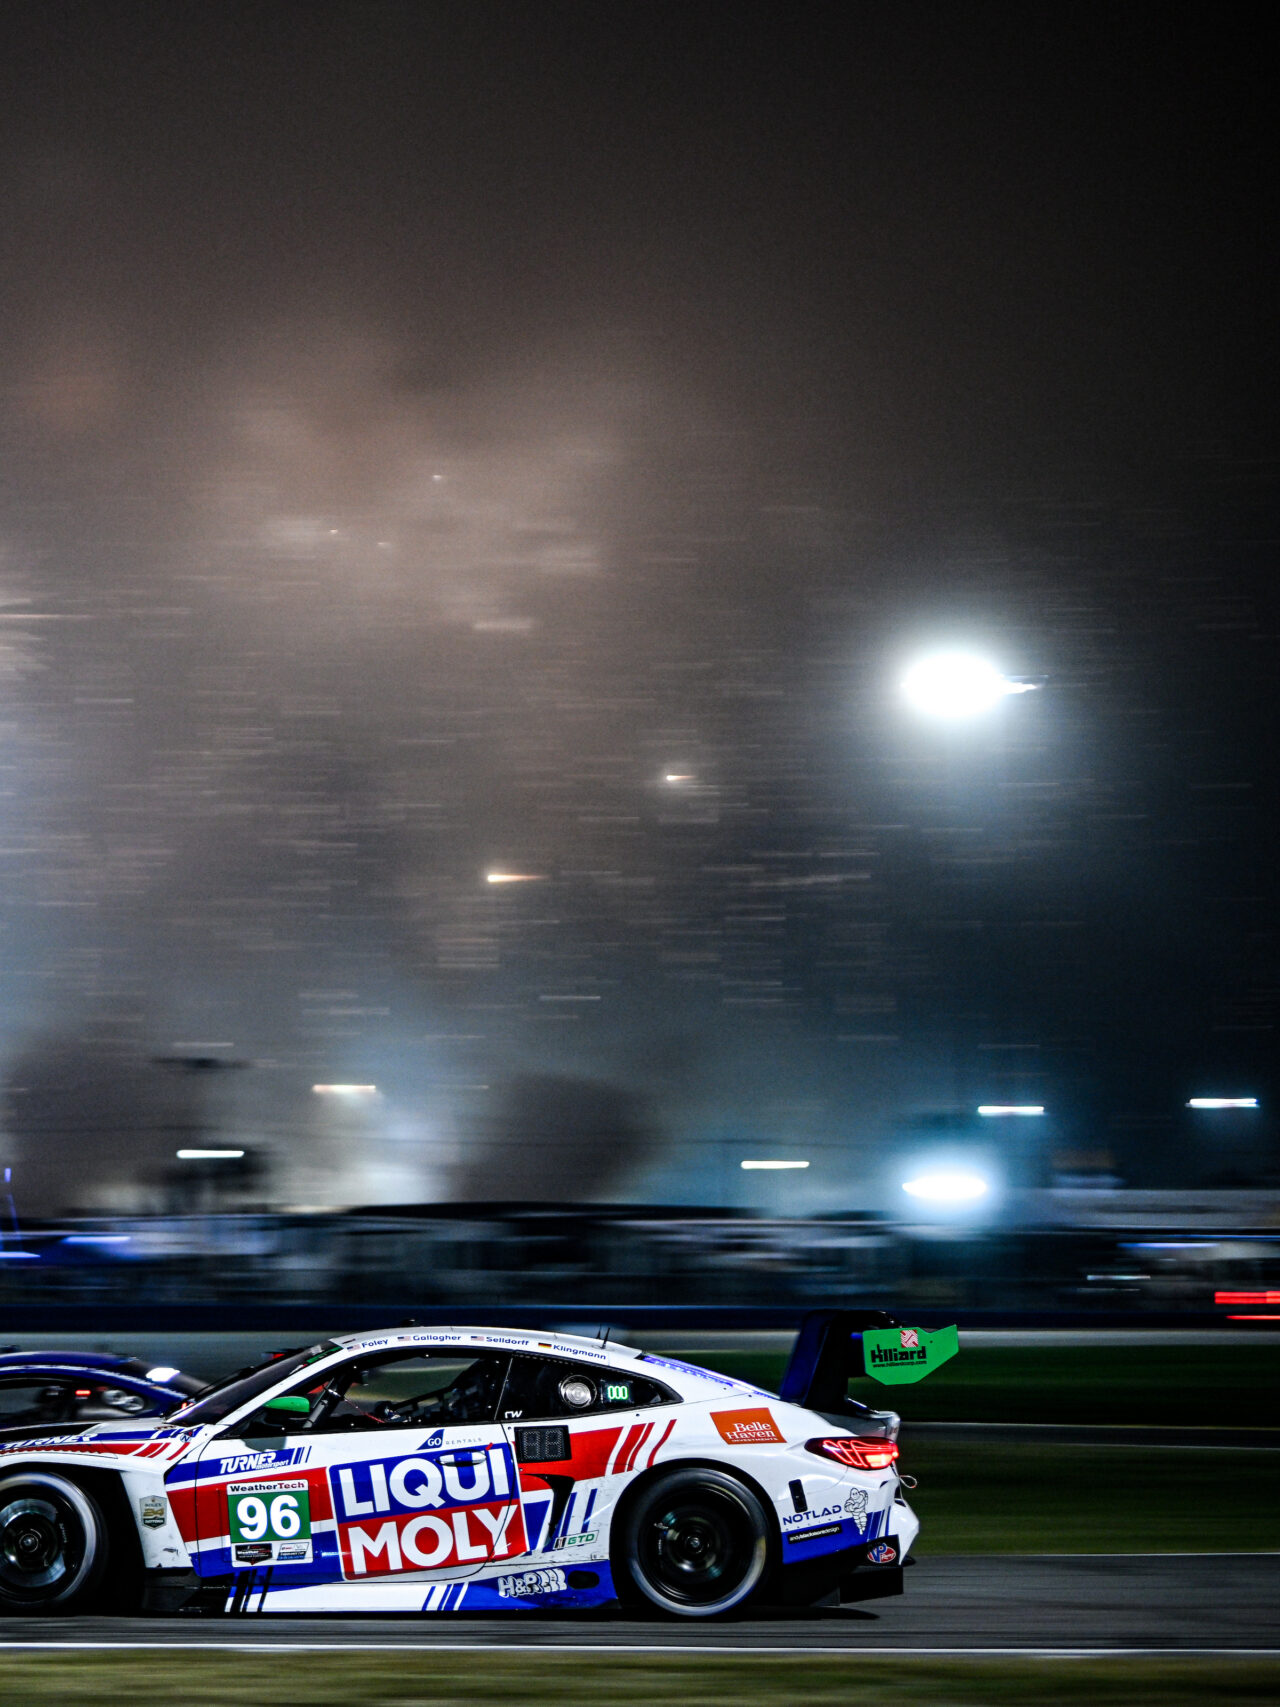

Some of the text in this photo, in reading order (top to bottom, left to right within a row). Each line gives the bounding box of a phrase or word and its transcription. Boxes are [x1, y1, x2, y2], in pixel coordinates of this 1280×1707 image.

[361, 1339, 389, 1348] Foley
[486, 1336, 529, 1346] Selldorff
[553, 1344, 607, 1360] Klingmann
[732, 1421, 772, 1432] Belle
[4, 1433, 98, 1449] TURNER
[427, 1437, 442, 1447] GO
[725, 1430, 776, 1440] Haven
[220, 1452, 276, 1474] TURNER
[230, 1481, 305, 1492] WeatherTech
[338, 1448, 511, 1517] LIQUI
[236, 1494, 301, 1540] 96
[783, 1505, 842, 1525] NOTLAD
[348, 1504, 518, 1575] MOLY
[567, 1533, 595, 1545] GTD
